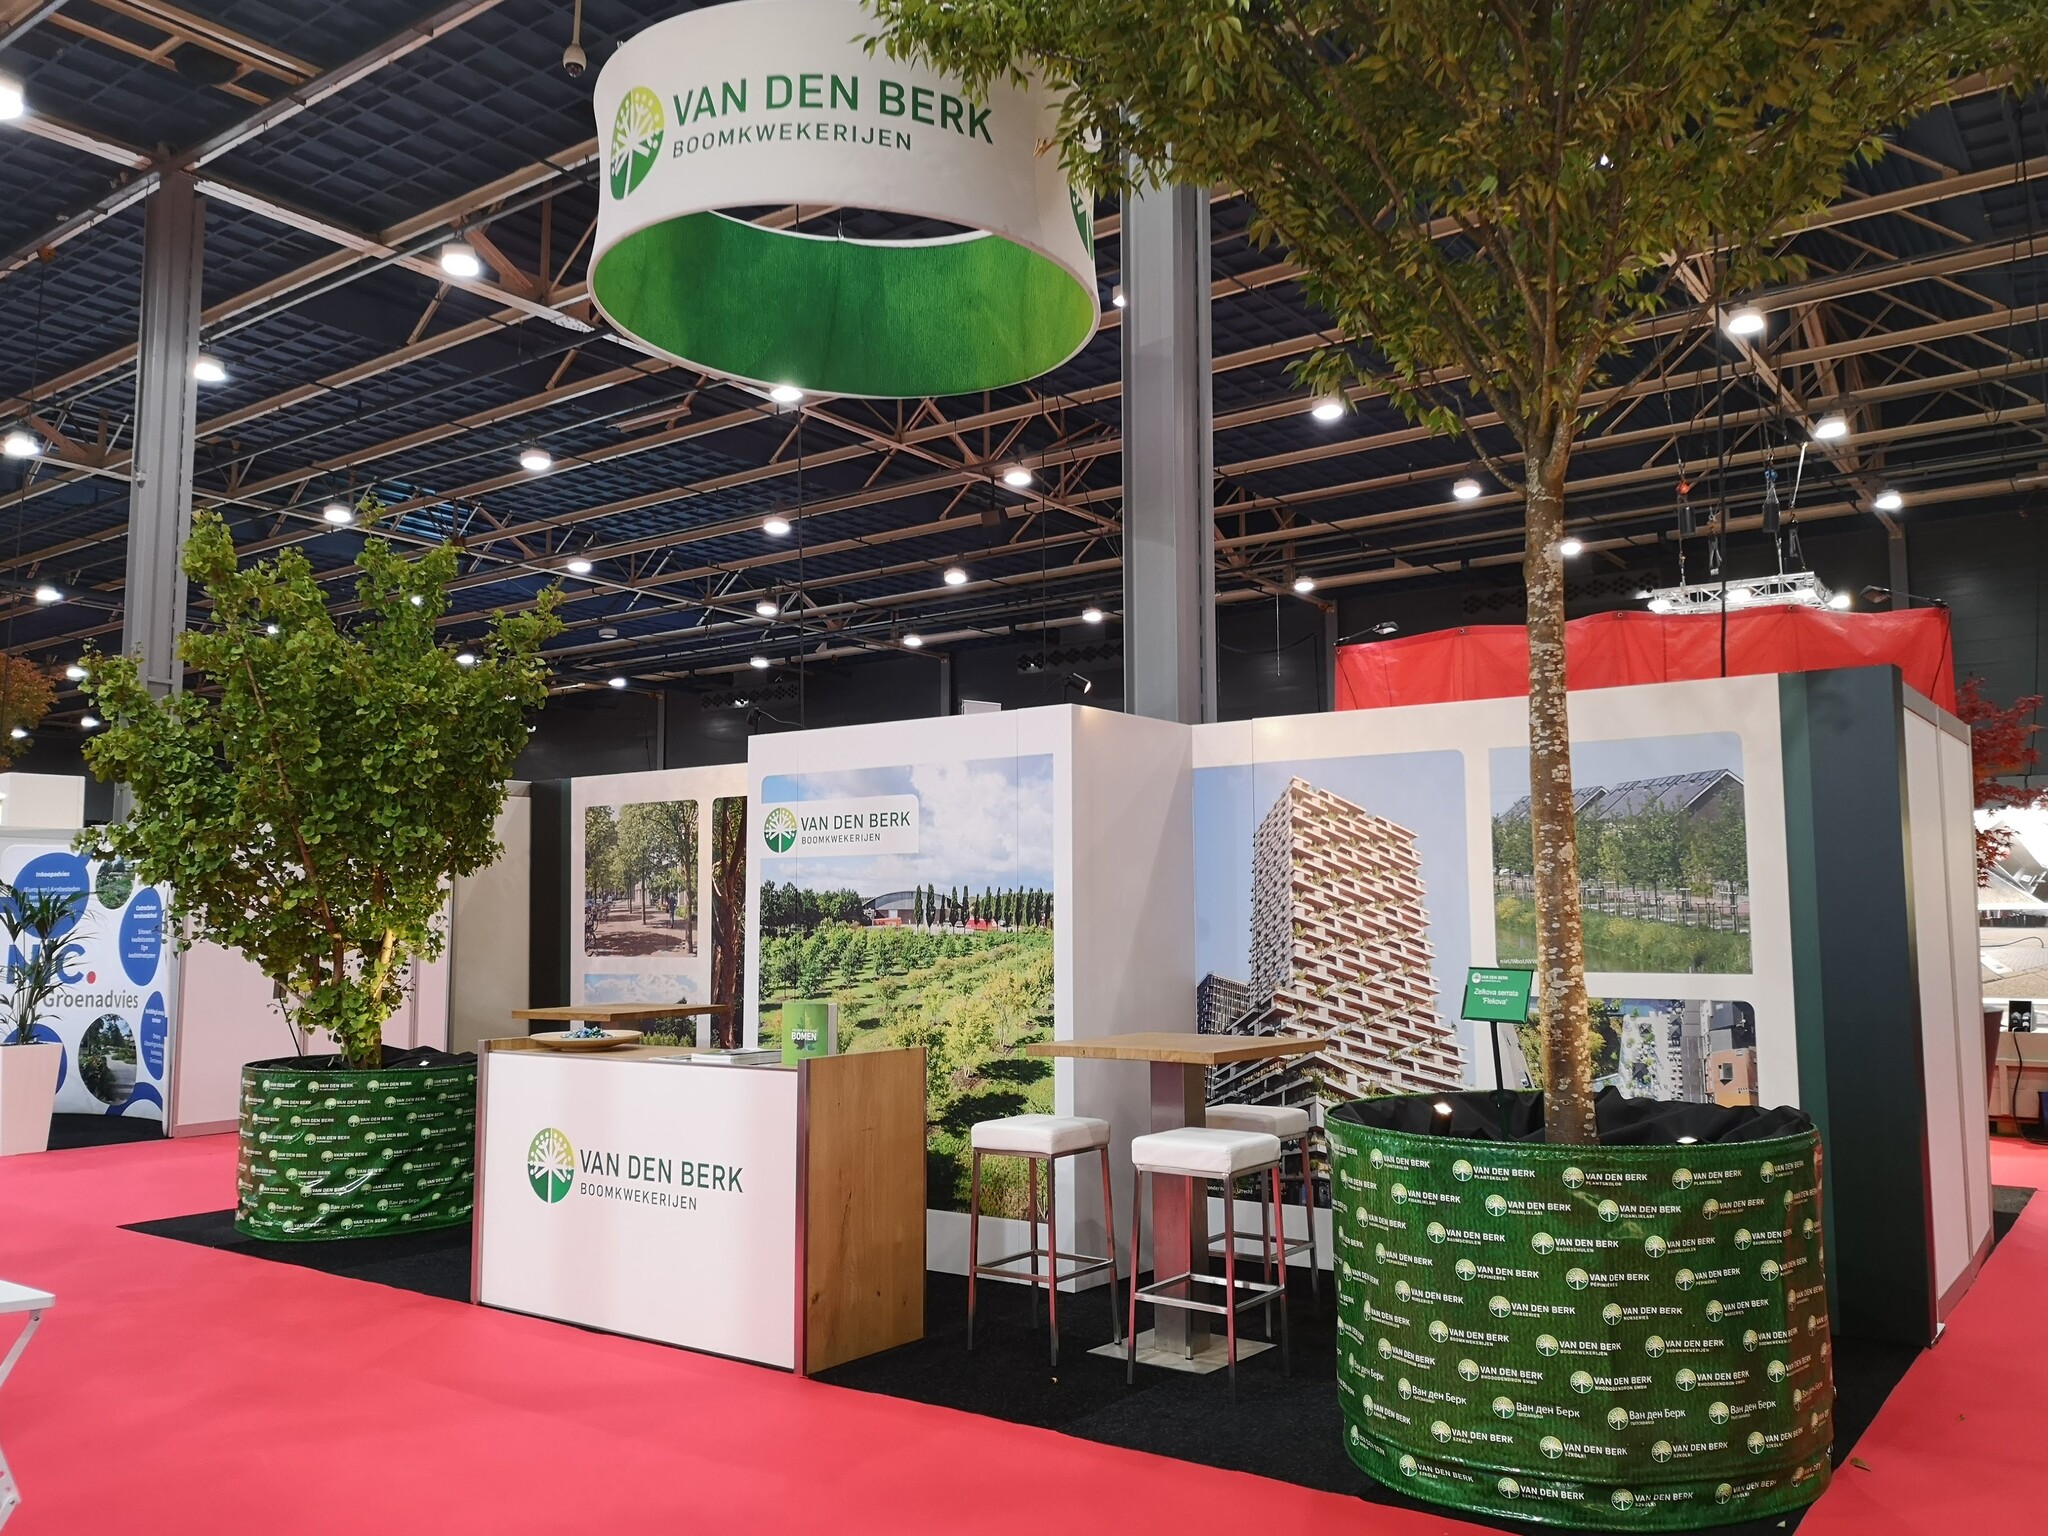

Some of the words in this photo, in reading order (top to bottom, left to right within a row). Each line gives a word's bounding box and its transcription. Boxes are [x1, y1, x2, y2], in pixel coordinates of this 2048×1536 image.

[672, 78, 747, 127] VAN
[766, 74, 858, 111] DEN
[879, 79, 993, 146] BERK
[672, 122, 911, 159] BOOMKWEKERIJEN
[800, 816, 828, 831] VAN
[834, 814, 864, 830] DEN
[869, 811, 911, 828] BERK
[801, 833, 881, 845] BOOMKWEKERIJEN
[6, 944, 96, 984] NC.
[1474, 988, 1497, 996] Zelkova
[43, 989, 138, 1009] Groenadvies
[791, 1032, 817, 1041] BOMEN
[1383, 1155, 1395, 1164] VAN
[1396, 1157, 1409, 1166] DEN
[1411, 1159, 1430, 1169] BERK
[579, 1149, 619, 1177] VAN
[628, 1155, 672, 1184] DEN
[681, 1161, 744, 1193] BERK
[1473, 1166, 1490, 1174] VAN
[1492, 1167, 1510, 1176] DEN
[1512, 1168, 1536, 1178] BERK
[1605, 1173, 1623, 1181] DEN
[1625, 1173, 1648, 1181] BERK
[1693, 1172, 1707, 1180] VAN
[1708, 1171, 1723, 1179] DEN
[1724, 1169, 1742, 1178] BERK
[580, 1182, 697, 1210] BOOMKWEKERIJEN
[1407, 1190, 1421, 1198] VAN
[1422, 1192, 1438, 1200] DEN
[1440, 1194, 1461, 1203] BERK
[1507, 1201, 1525, 1209] VAN
[1527, 1202, 1545, 1210] DEN
[1547, 1203, 1571, 1211] BERK
[1620, 1205, 1637, 1213] VAN
[1659, 1206, 1681, 1214] BERK
[1446, 1228, 1461, 1237] VAN
[1463, 1231, 1481, 1239] DEN
[1482, 1232, 1506, 1242] BERK
[1555, 1238, 1572, 1247] VAN
[1575, 1239, 1594, 1248] DEN
[1596, 1240, 1619, 1248] BERK
[1666, 1240, 1681, 1248] VAN
[1682, 1239, 1696, 1247] DEN
[1697, 1237, 1716, 1246] BERK
[1476, 1265, 1494, 1274] VAN
[1495, 1268, 1513, 1276] DEN
[1515, 1269, 1539, 1279] BERK
[1589, 1273, 1607, 1282] VAN
[1609, 1274, 1625, 1282] DEN
[1627, 1273, 1650, 1281] BERK
[1411, 1288, 1423, 1297] VAN
[1425, 1291, 1441, 1301] DEN
[1443, 1294, 1464, 1304] BERK
[1511, 1302, 1528, 1311] VAN
[1531, 1304, 1549, 1313] DEN
[1551, 1306, 1576, 1315] BERK
[1622, 1307, 1638, 1315] VAN
[1660, 1307, 1683, 1315] BERK
[1723, 1303, 1735, 1311] VAN
[1736, 1301, 1750, 1309] DEN
[1751, 1299, 1769, 1307] BERK
[1449, 1328, 1464, 1337] VAN
[1466, 1331, 1484, 1340] DEN
[1486, 1333, 1509, 1343] BERK
[1559, 1340, 1577, 1349] VAN
[1580, 1341, 1598, 1350] DEN
[1600, 1342, 1621, 1351] BERK
[1665, 1340, 1682, 1348] VAN
[1684, 1340, 1701, 1348] DEN
[1703, 1339, 1724, 1347] BERK
[1480, 1366, 1497, 1375] VAN
[1499, 1368, 1517, 1377] DEN
[1520, 1371, 1543, 1380] BERK
[1697, 1373, 1713, 1381] VAN
[1714, 1372, 1732, 1380] DEN
[1733, 1370, 1750, 1379] BERK
[1593, 1376, 1612, 1386] VAN
[1614, 1377, 1629, 1385] DEN
[1631, 1376, 1652, 1384] BERK
[1412, 1385, 1426, 1396] Ван
[1428, 1390, 1444, 1400] ден
[1445, 1392, 1467, 1405] Берк
[1516, 1402, 1534, 1412] Ван
[1535, 1405, 1554, 1414] ден
[1556, 1406, 1580, 1418] Берк
[1730, 1405, 1743, 1415] Ван
[1744, 1403, 1757, 1413] ден
[1758, 1400, 1776, 1410] Берк
[1629, 1410, 1645, 1420] Ван
[1647, 1411, 1663, 1421] ден
[1664, 1408, 1686, 1419] Берк
[1451, 1428, 1468, 1438] VAN
[1470, 1431, 1488, 1441] DEN
[1490, 1433, 1514, 1444] BERK
[1563, 1443, 1582, 1452] VAN
[1583, 1446, 1603, 1454] DEN
[1605, 1447, 1628, 1456] BERK
[1690, 1443, 1707, 1451] DEN
[1709, 1442, 1728, 1450] BERK
[1417, 1463, 1433, 1473] VAN
[1435, 1468, 1451, 1477] DEN
[1452, 1472, 1474, 1482] BERK
[1520, 1486, 1538, 1495] VAN
[1540, 1488, 1559, 1497] DEN
[1560, 1491, 1585, 1500] BERK
[1634, 1494, 1651, 1502] VAN
[1653, 1493, 1671, 1501] DEN
[1673, 1492, 1693, 1500] BERK
